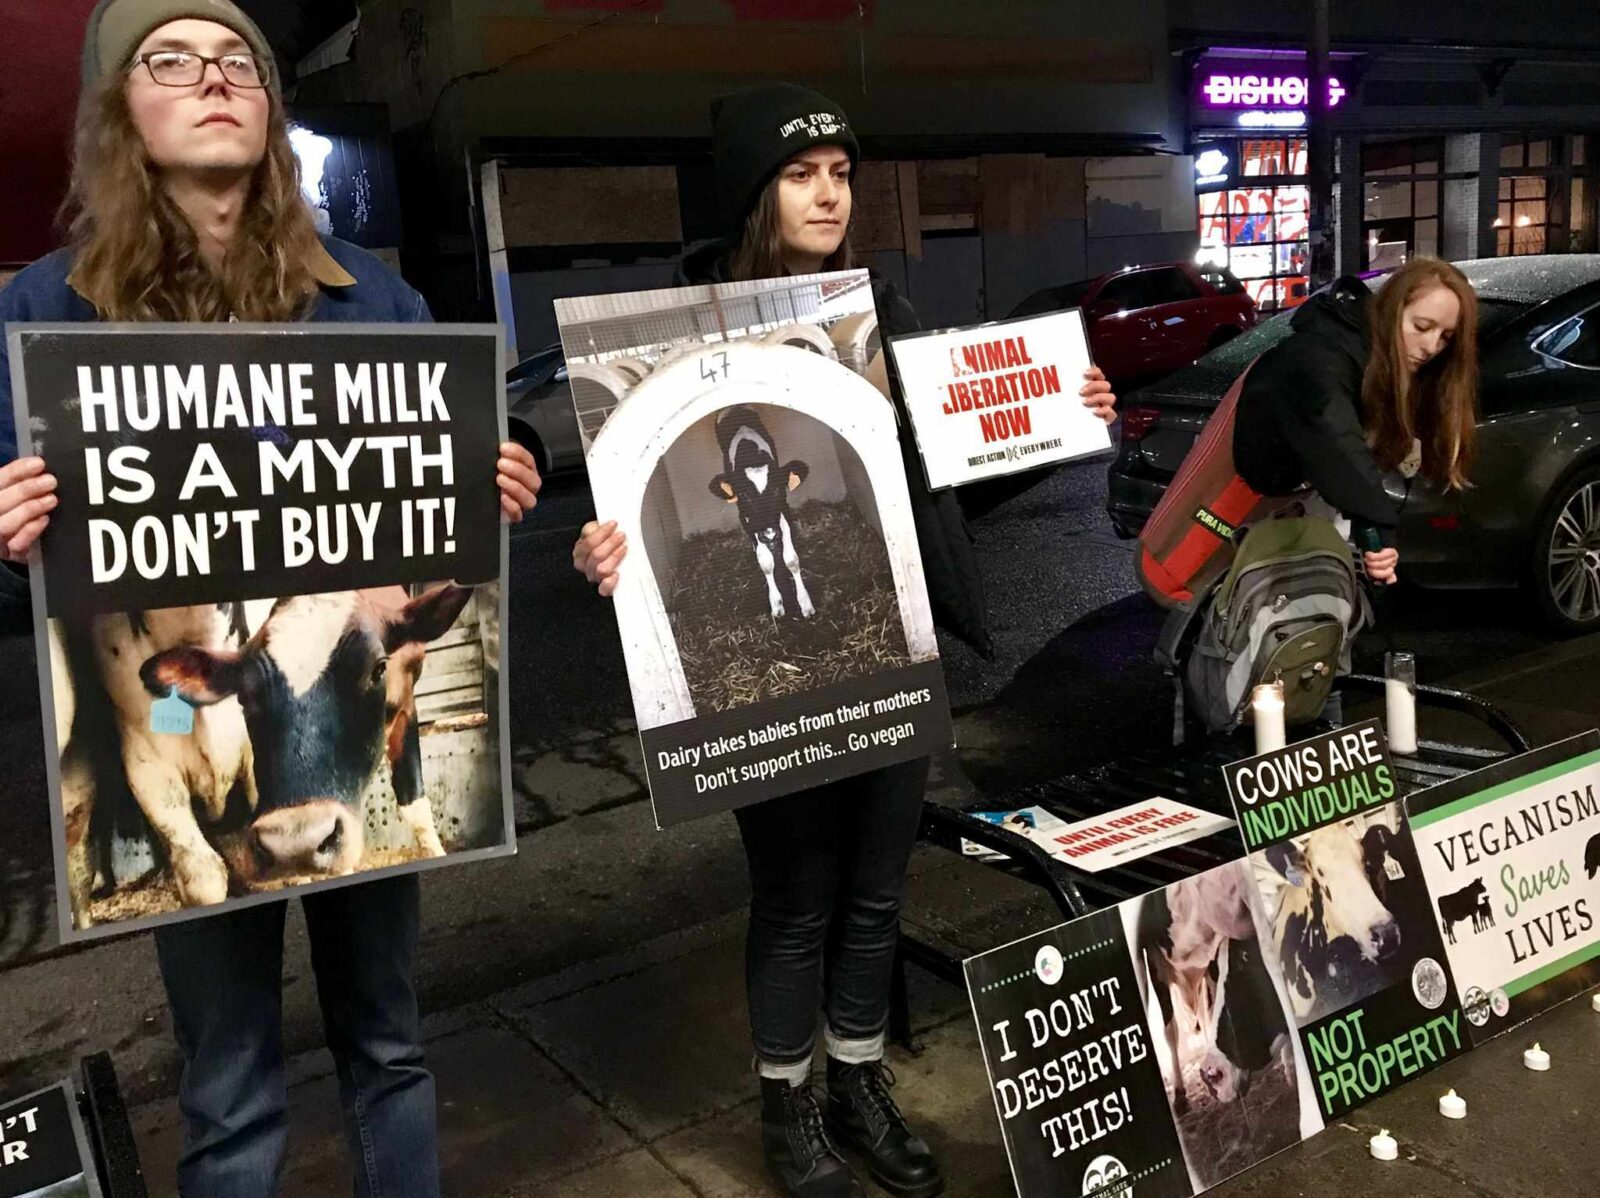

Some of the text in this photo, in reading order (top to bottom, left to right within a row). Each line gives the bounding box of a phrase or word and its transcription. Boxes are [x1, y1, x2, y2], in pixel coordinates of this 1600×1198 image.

[780, 117, 808, 138] UNTIL
[806, 125, 819, 138] IS
[77, 362, 451, 432] HUMANE MILK
[700, 351, 731, 383] 47
[968, 455, 986, 467] DIRECT
[986, 451, 1006, 463] ACTION
[1019, 438, 1063, 455] EVERYWHERE
[979, 406, 1032, 443] NOW
[85, 434, 454, 505] IS A MYTH
[87, 497, 456, 583] DON'T BUY IT!
[1196, 509, 1218, 529] PURA
[658, 686, 931, 770] Dairy takes babies from their mothers
[694, 722, 915, 794] Don't support this... Go vegan
[1236, 727, 1382, 805] COWS ARE
[1053, 825, 1114, 845] UNTIL
[1105, 807, 1165, 829] EVERY
[1062, 832, 1139, 858] ANIMAL
[1130, 825, 1159, 835] IS
[1151, 811, 1200, 829] FREE
[1242, 764, 1394, 846] INDIVIDUALS
[1433, 784, 1600, 872] VEGANISM
[1500, 859, 1570, 917] Saves
[1505, 898, 1593, 964] LIVES
[993, 977, 1122, 1062] I DON'T
[1307, 1009, 1367, 1072] NOT
[996, 1024, 1147, 1119] DESERVE
[1318, 1009, 1461, 1115] PROPERTY
[0, 1107, 39, 1143] 'T
[0, 1141, 30, 1168] R
[1040, 1086, 1133, 1158] THIS!
